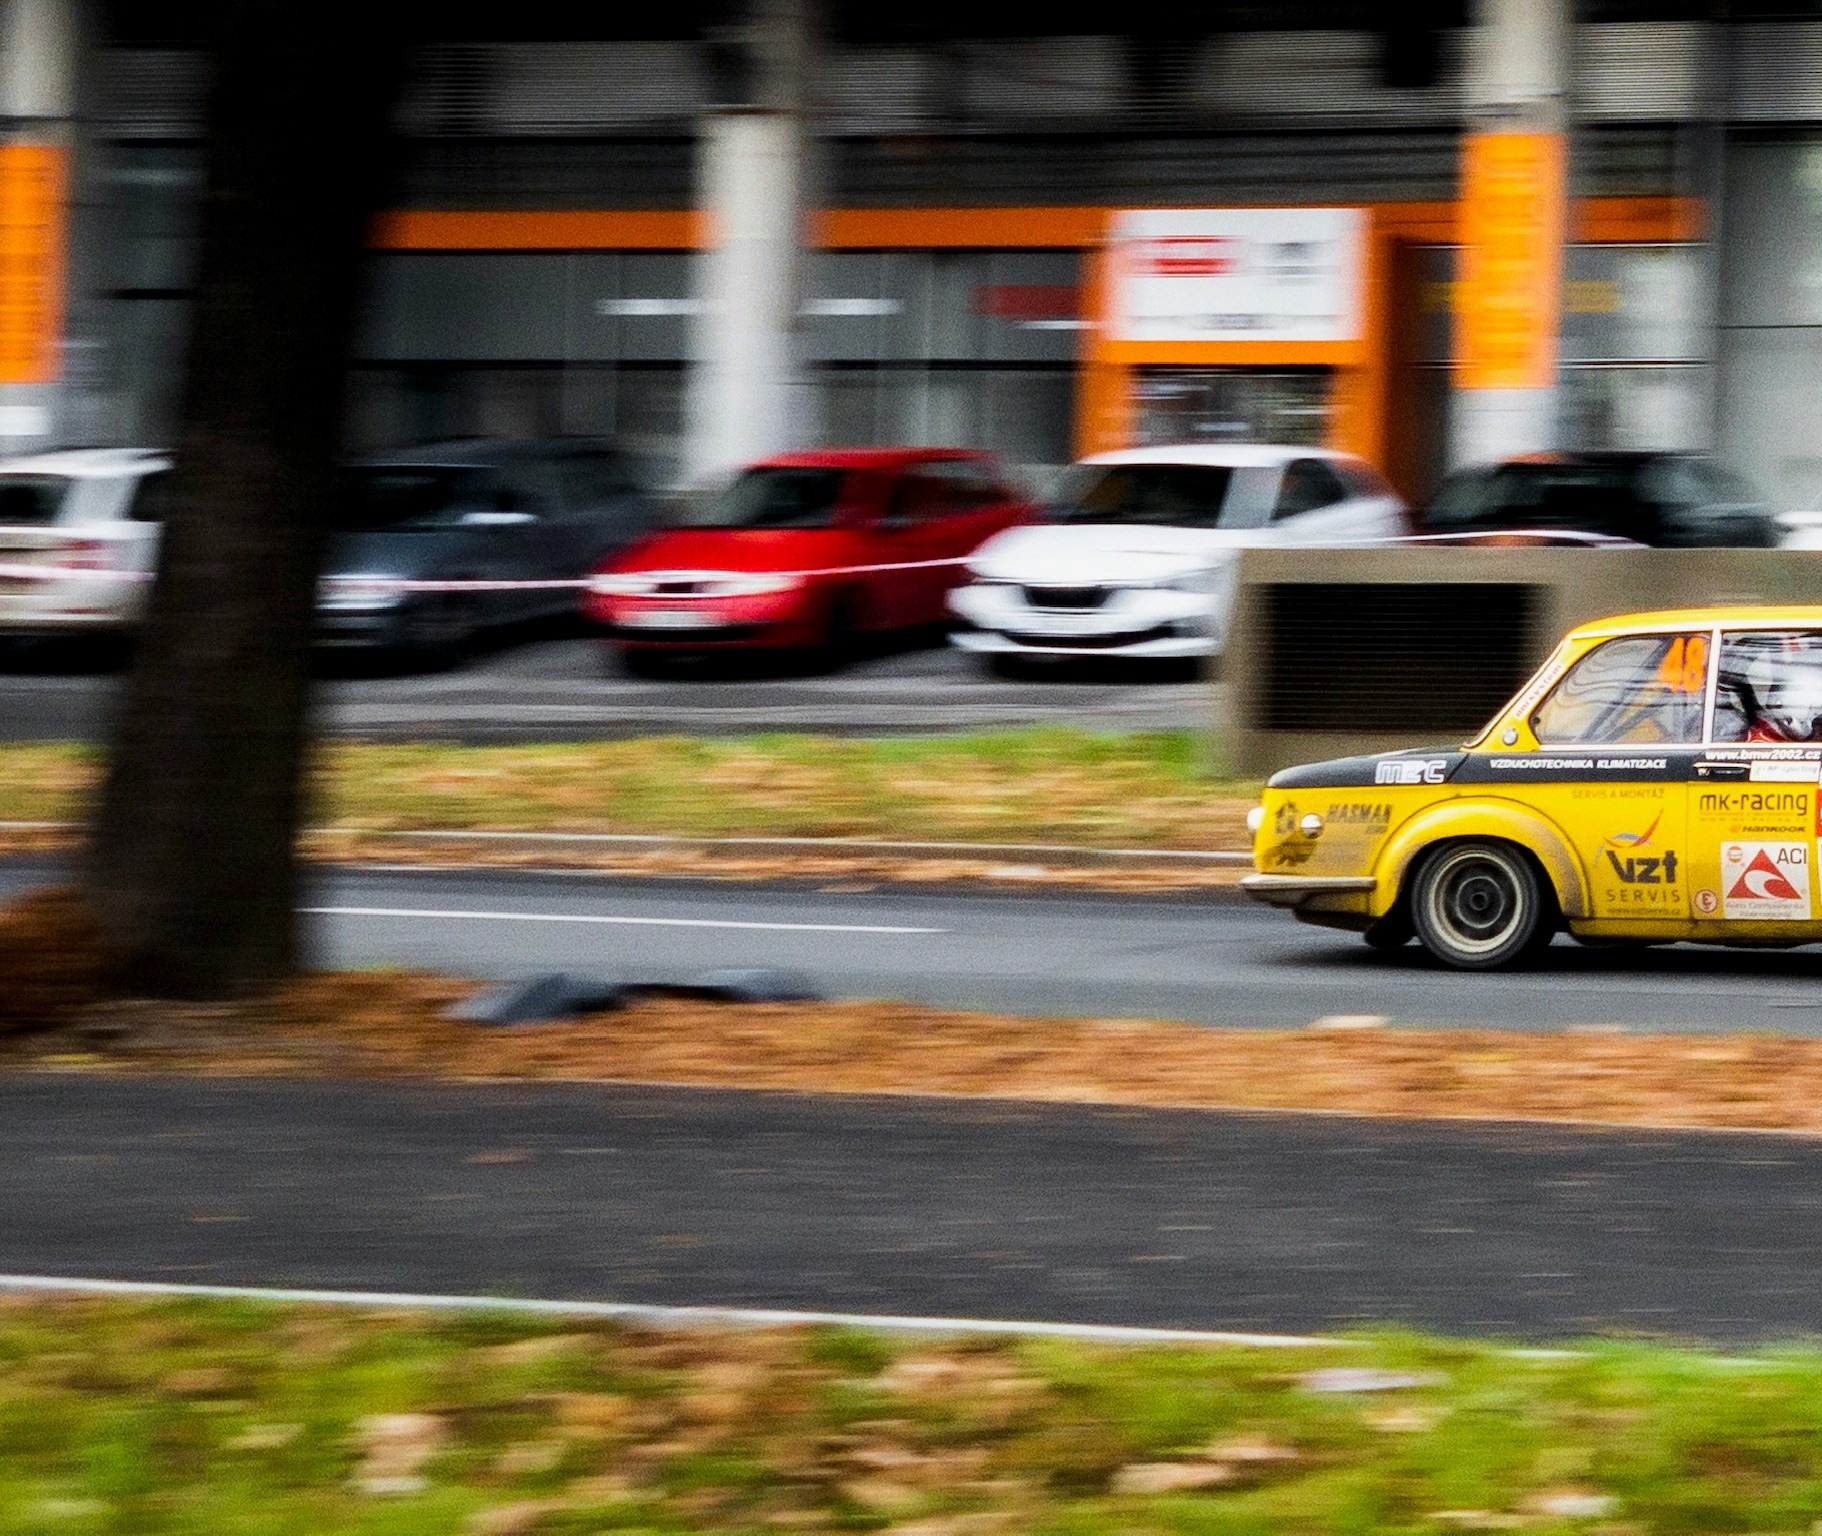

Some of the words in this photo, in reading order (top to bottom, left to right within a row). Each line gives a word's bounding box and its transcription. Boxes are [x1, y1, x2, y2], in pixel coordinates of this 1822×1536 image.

[1660, 637, 1707, 694] 48
[1705, 749, 1821, 760] www.bmw2002.cz
[1490, 759, 1593, 769] VZDUCHOTECHNIKA
[1597, 759, 1667, 769] KLIMATIZACE
[1572, 789, 1609, 800] SERVIS
[1610, 789, 1617, 799] A
[1700, 793, 1807, 816] mk-racing
[1777, 848, 1807, 865] ACI
[1607, 889, 1680, 902] SERVIS
